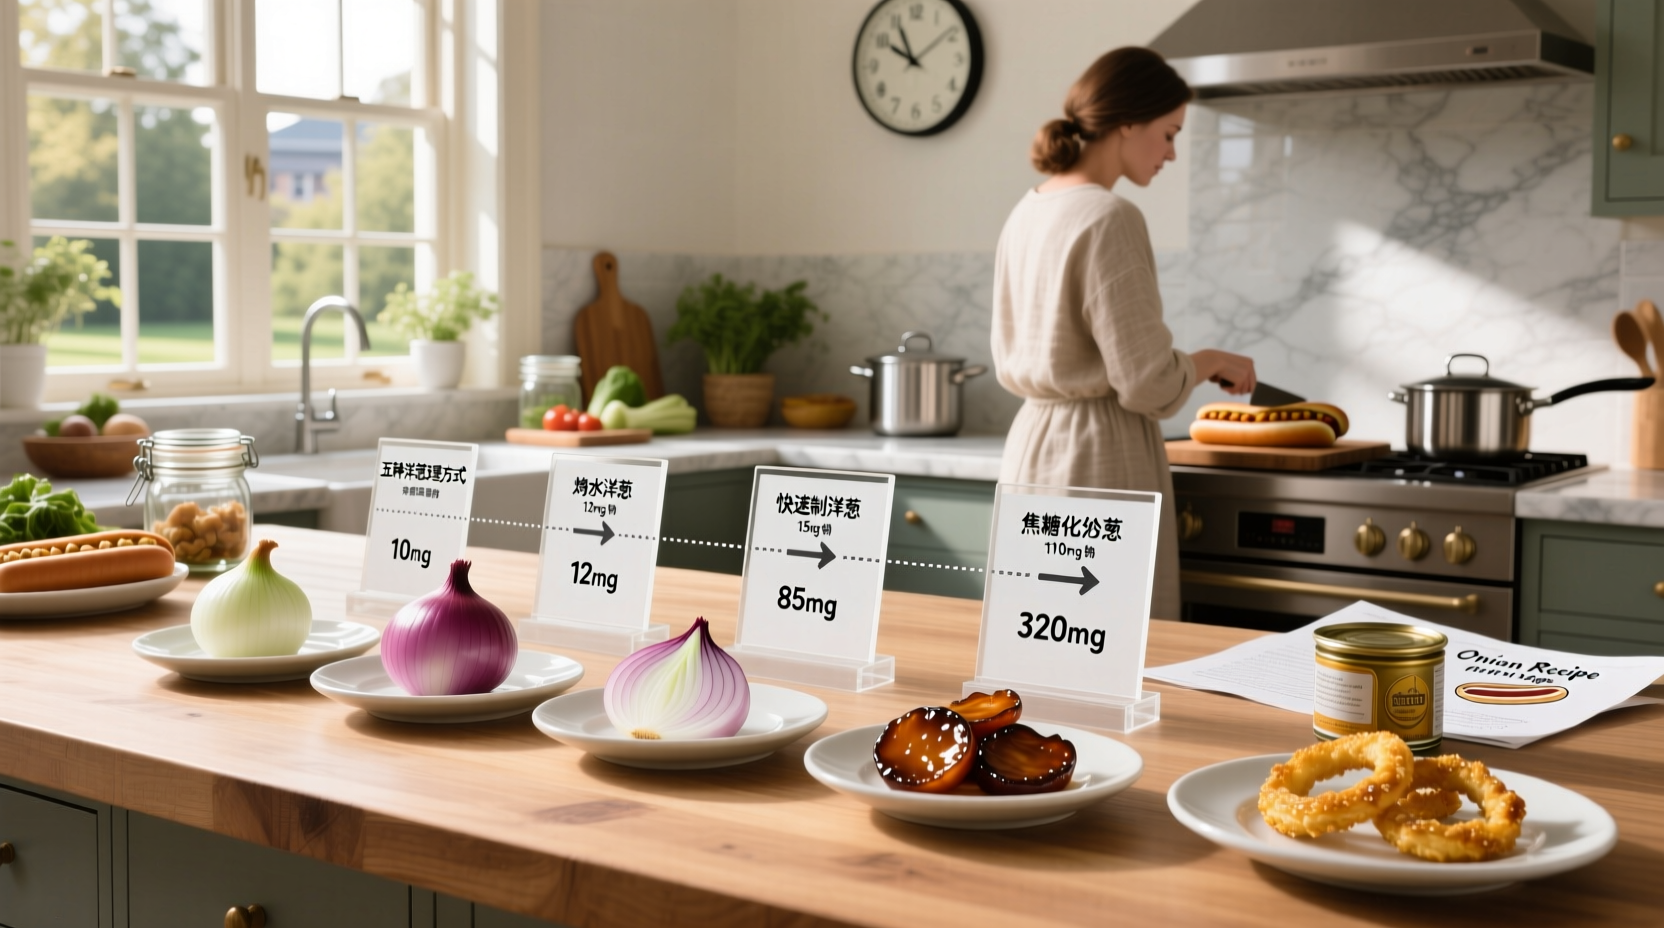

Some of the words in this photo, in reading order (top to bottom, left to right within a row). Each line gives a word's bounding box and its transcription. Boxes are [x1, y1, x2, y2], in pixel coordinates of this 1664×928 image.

[890, 96, 901, 115] 7
[911, 102, 921, 120] 6
[391, 538, 431, 568] 10mg
[571, 561, 618, 594] 12mg
[777, 585, 837, 622] 85mg
[1017, 611, 1106, 654] 320mg
